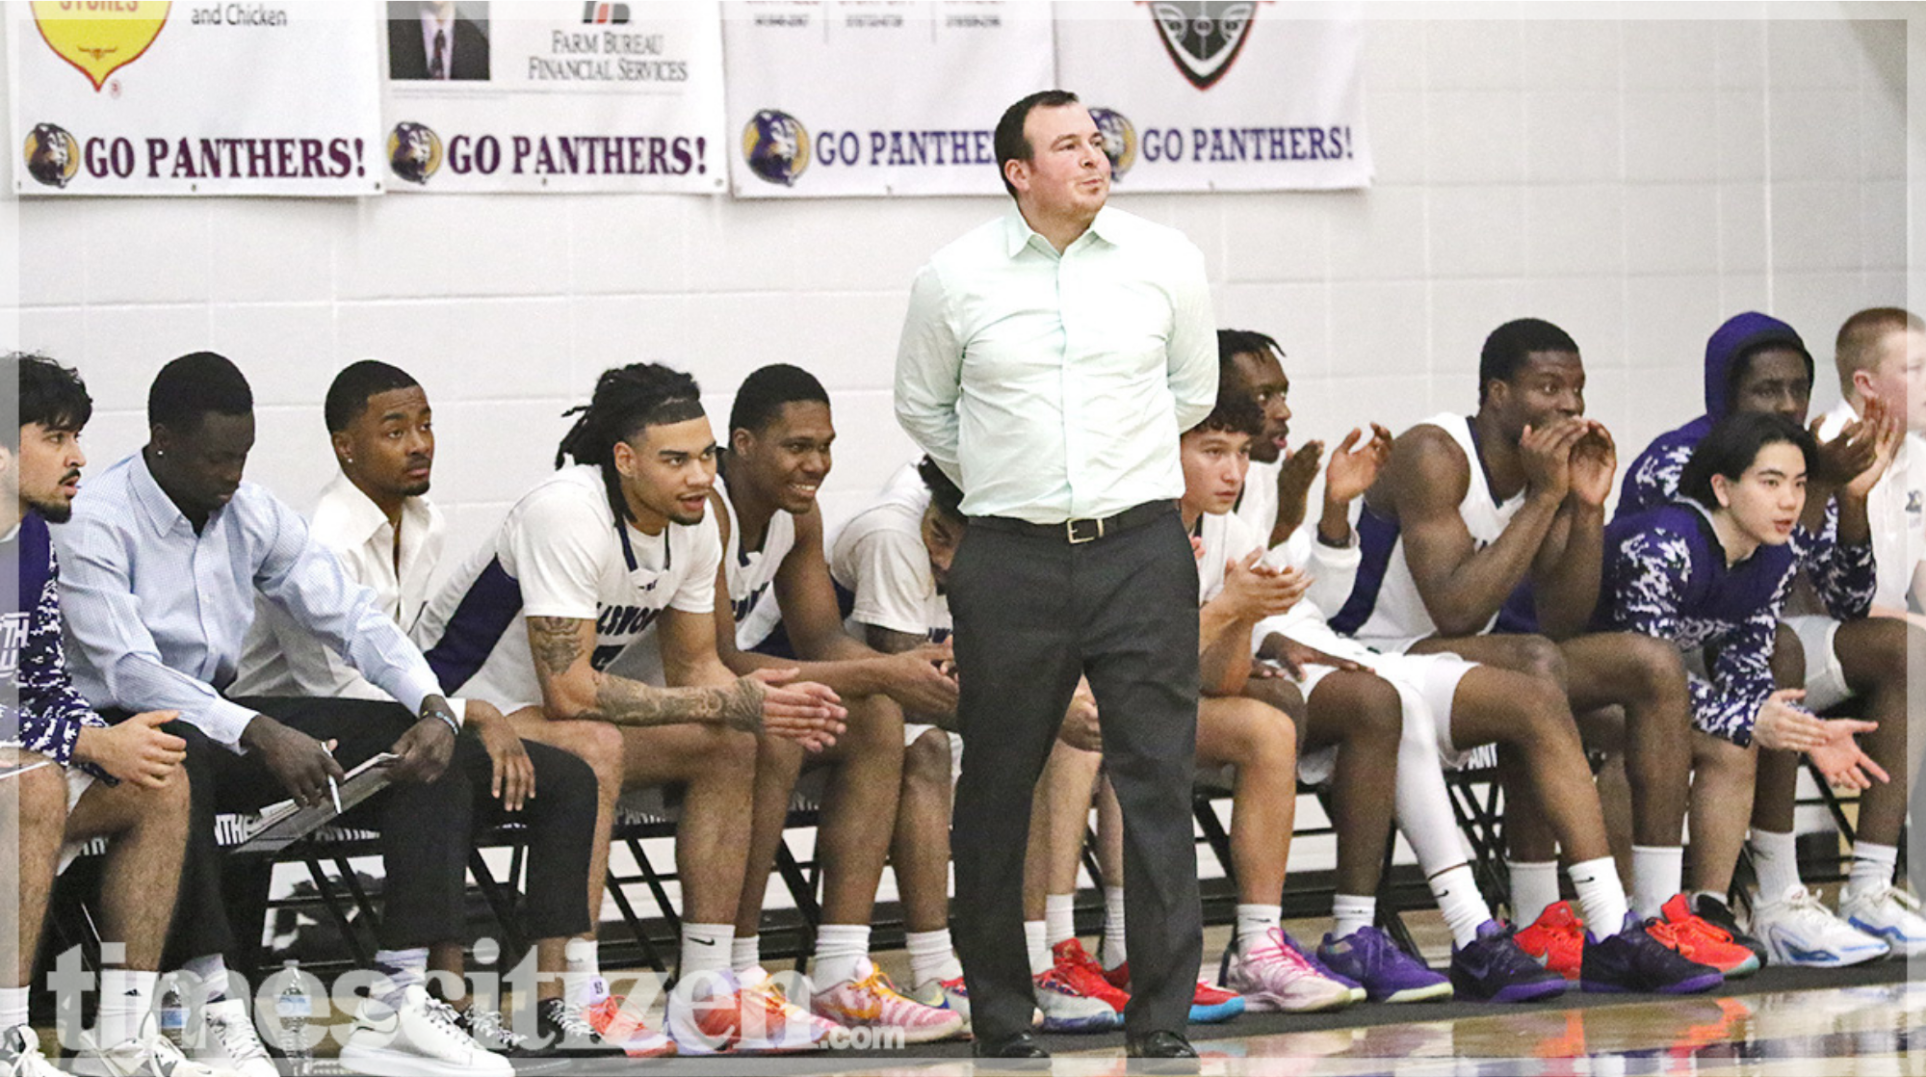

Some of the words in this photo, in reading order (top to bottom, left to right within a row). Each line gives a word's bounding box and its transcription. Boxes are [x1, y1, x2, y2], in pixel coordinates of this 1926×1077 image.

[192, 2, 221, 25] and
[226, 3, 287, 26] Chicken
[552, 30, 598, 54] FARM
[603, 31, 664, 55] BUREAU
[528, 56, 614, 80] FINANCIAL
[617, 58, 688, 81] SERVICES
[84, 137, 135, 179] GO
[146, 136, 365, 179] PANTHERS!
[447, 134, 500, 175] GO
[512, 136, 706, 175] PANTHERS!
[816, 131, 860, 166] GO
[869, 131, 998, 165] PANTHE
[1142, 129, 1184, 162] GO
[1192, 127, 1353, 162] PANTHERS!
[0, 613, 30, 649] TH
